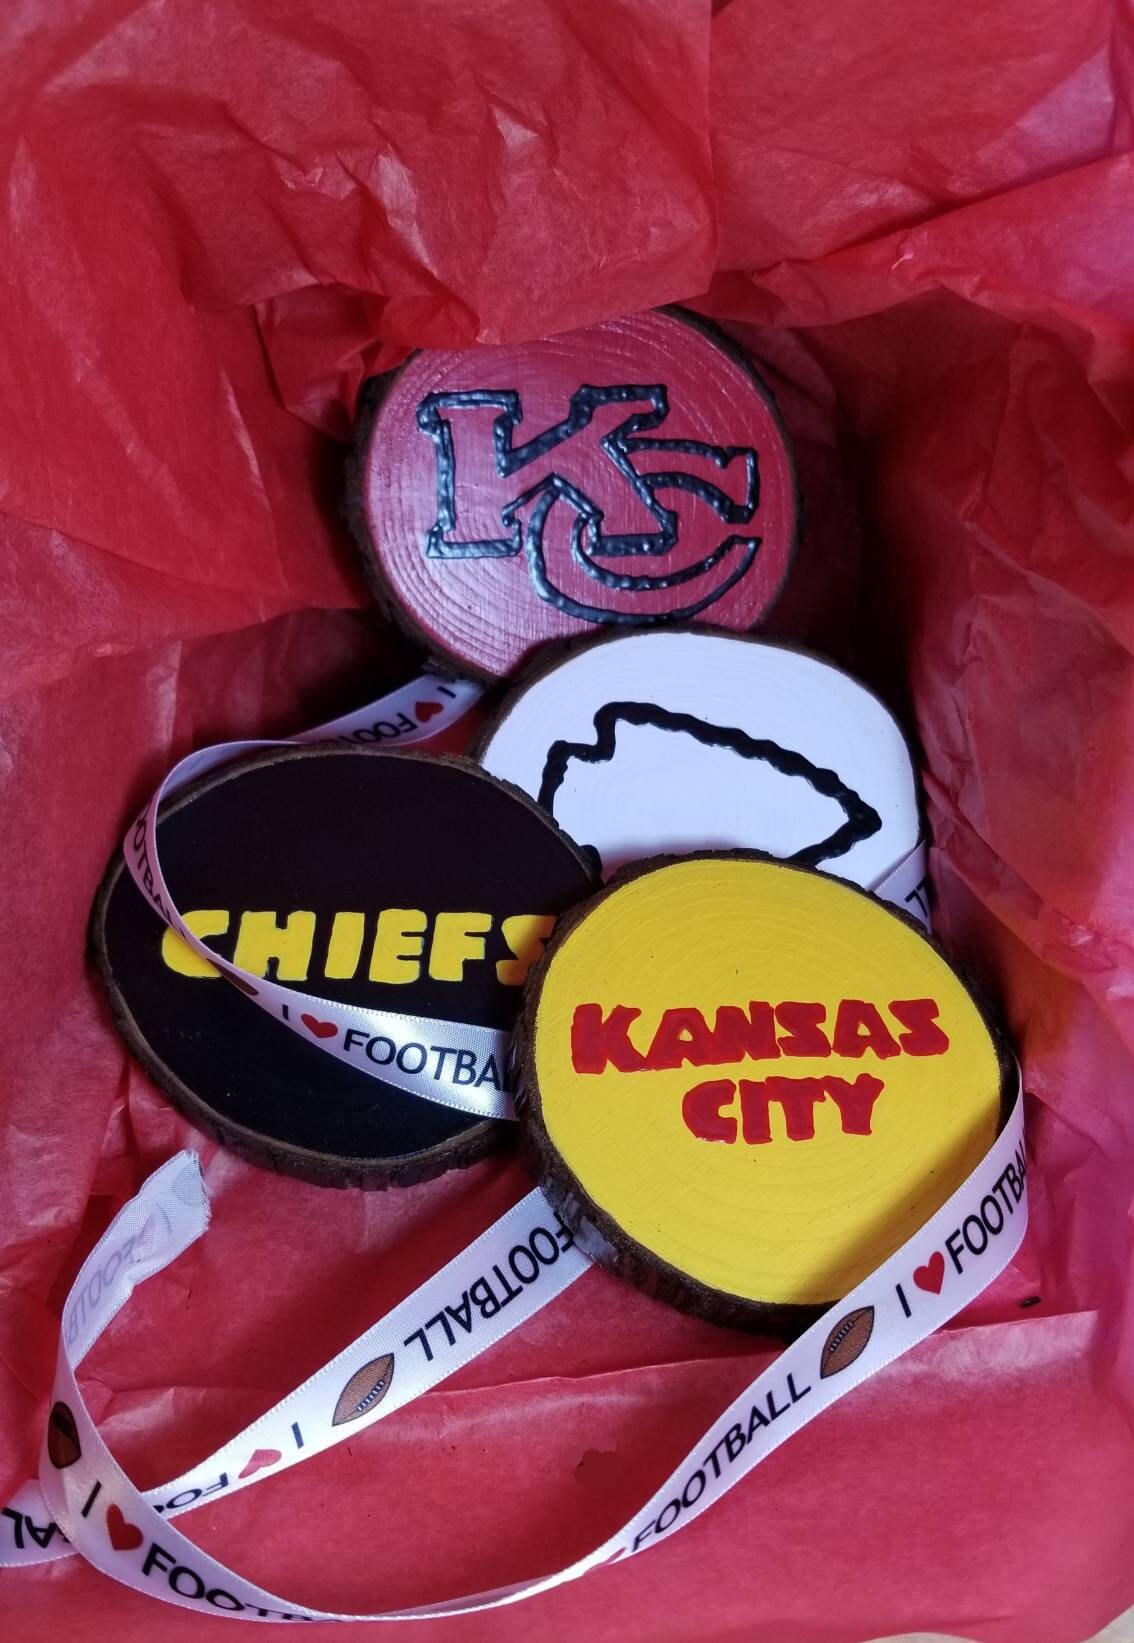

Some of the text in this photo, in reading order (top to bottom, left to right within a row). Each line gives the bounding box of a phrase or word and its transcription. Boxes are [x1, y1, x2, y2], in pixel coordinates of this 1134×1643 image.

[417, 384, 762, 625] KC
[161, 908, 557, 985] CHIEFS
[281, 1004, 290, 1022] I
[570, 998, 950, 1075] KANSAS
[682, 1073, 885, 1145] CITY
[895, 1128, 1027, 1318] I FOOTBA
[403, 1211, 575, 1362] FOOTBALL
[291, 1421, 305, 1449] I
[631, 1372, 812, 1553] FOOTBALL
[81, 1480, 103, 1519] I
